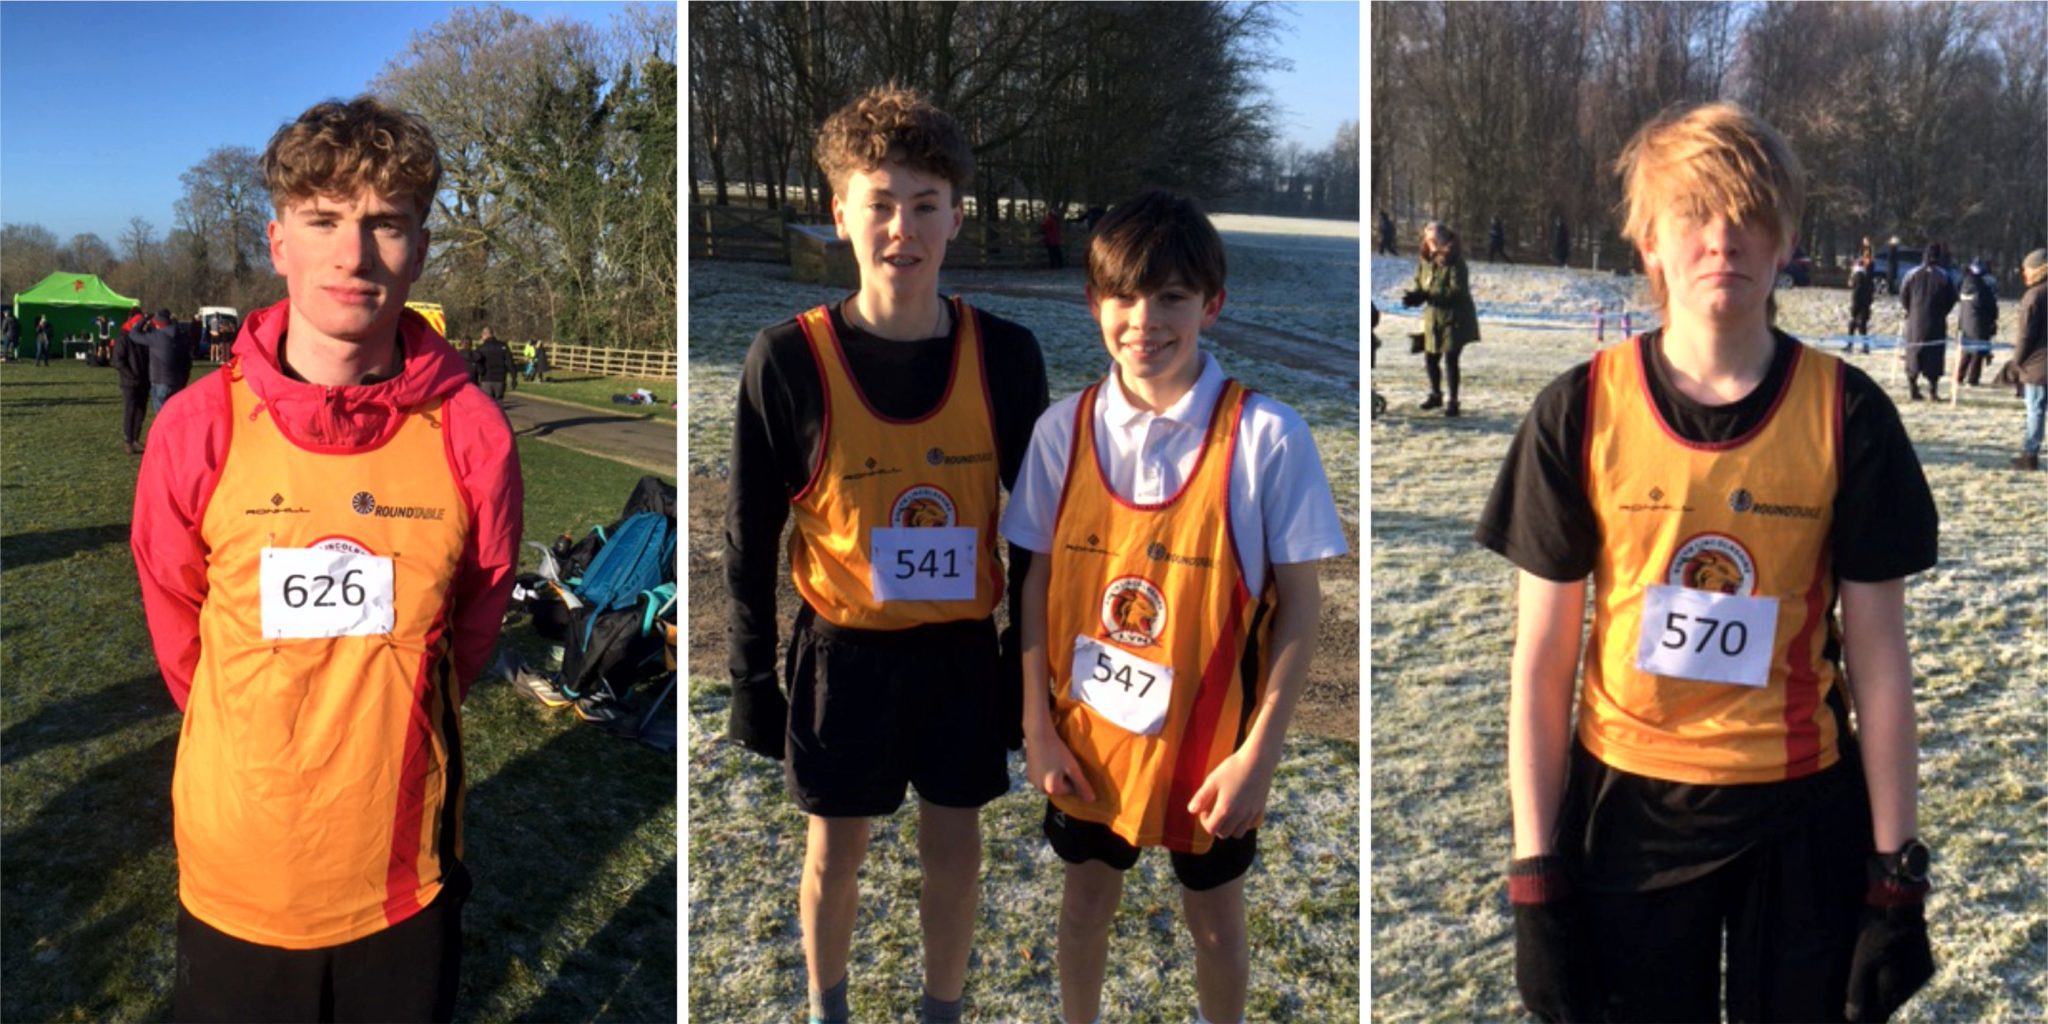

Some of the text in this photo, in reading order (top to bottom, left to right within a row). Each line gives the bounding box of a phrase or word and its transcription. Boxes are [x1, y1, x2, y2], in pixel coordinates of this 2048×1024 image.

[374, 505, 445, 520] ROUNDTABLE
[895, 549, 960, 579] 541
[283, 569, 366, 609] 626
[1662, 612, 1748, 657] 570
[1092, 653, 1156, 698] 547
